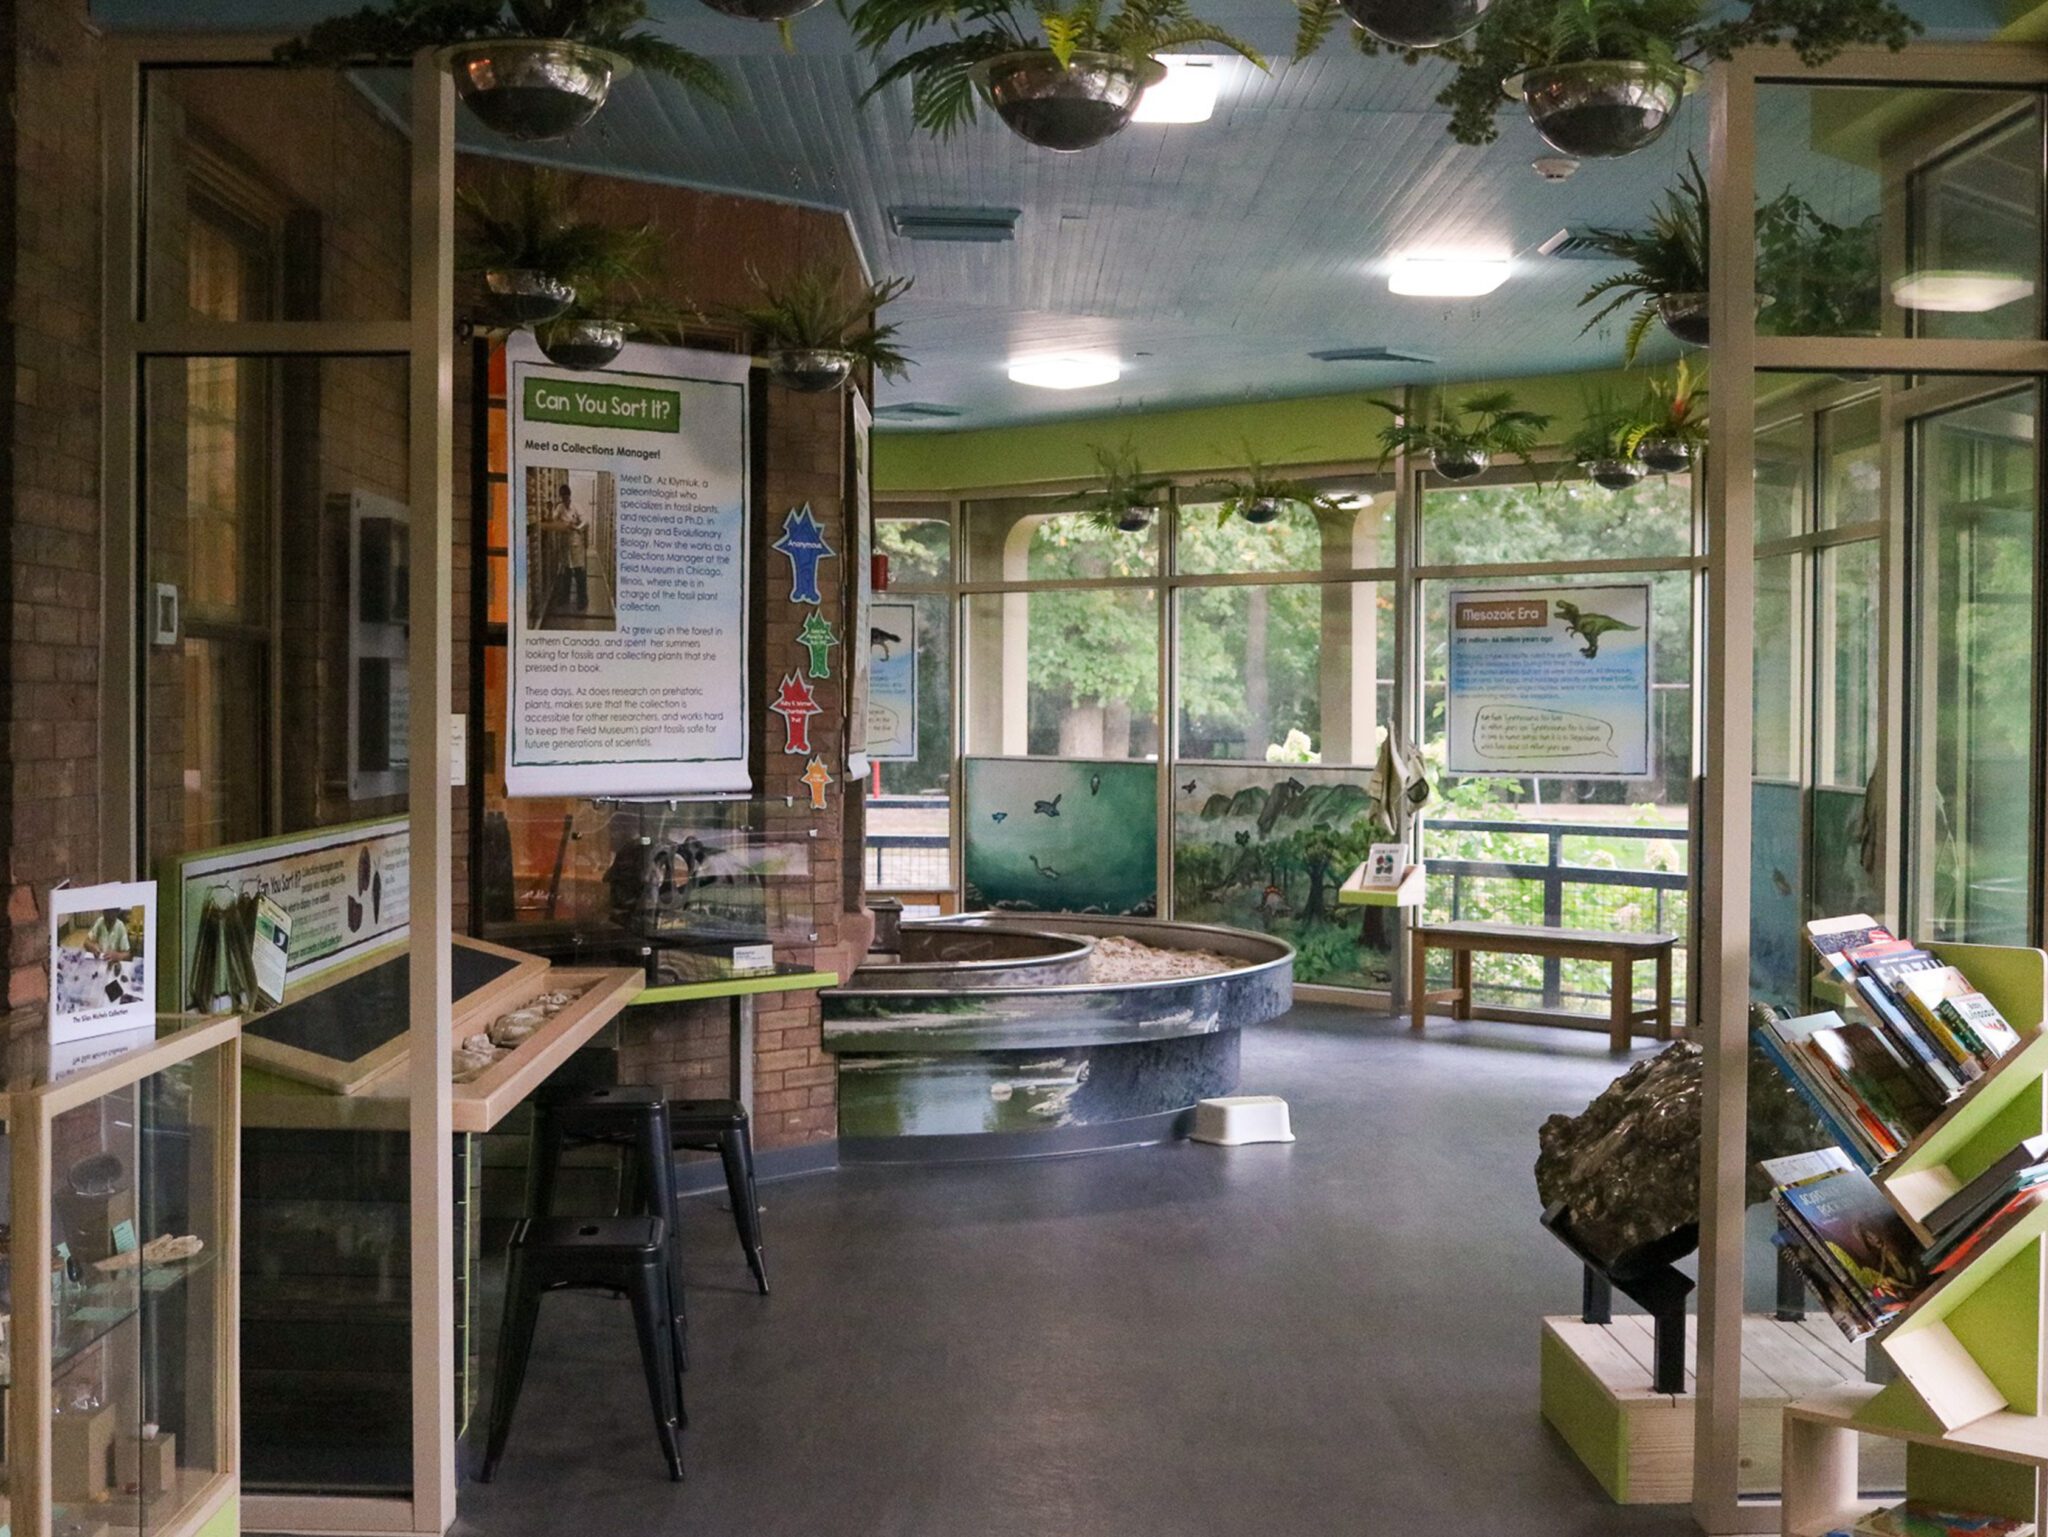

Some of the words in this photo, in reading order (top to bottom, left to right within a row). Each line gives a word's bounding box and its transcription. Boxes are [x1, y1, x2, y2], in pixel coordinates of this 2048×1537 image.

[535, 389, 570, 411] Can
[575, 393, 607, 414] You
[611, 396, 648, 418] Sort
[651, 399, 670, 420] It?
[525, 440, 550, 451] Meet
[552, 443, 559, 452] a
[561, 442, 614, 456] Collections
[616, 447, 661, 460] Manager!
[620, 473, 641, 483] Meet
[657, 477, 666, 485] Az
[620, 487, 678, 500] paleontologist
[620, 501, 663, 510] specializes
[674, 503, 691, 511] fossil
[620, 513, 637, 521] and
[639, 515, 675, 524] received
[620, 525, 652, 536] Ecology
[655, 528, 671, 536] and
[673, 528, 721, 539] Evolutionary
[653, 540, 672, 548] Now
[690, 543, 712, 551] works
[788, 539, 822, 549] Anonymous
[620, 550, 664, 560] Collections
[667, 554, 704, 565] Manager
[620, 563, 639, 573] Field
[641, 565, 675, 574] Museum
[677, 566, 684, 574] in
[647, 578, 672, 587] where
[674, 579, 688, 587] she
[620, 590, 649, 600] charge
[652, 591, 660, 599] of
[663, 591, 675, 599] the
[678, 591, 695, 600] fossil
[697, 592, 718, 601] plant
[1463, 608, 1516, 621] Mesozoic
[1518, 607, 1539, 619] Era
[632, 627, 652, 636] grew
[655, 628, 665, 636] up
[676, 627, 689, 635] the
[692, 627, 713, 635] forest
[526, 637, 560, 646] northern
[624, 639, 646, 648] spent
[650, 639, 663, 647] her
[666, 640, 701, 648] summers
[526, 650, 555, 661] looking
[558, 651, 569, 659] for
[571, 650, 594, 659] fossils
[596, 651, 614, 660] and
[616, 652, 656, 661] collecting
[658, 652, 682, 661] plants
[685, 652, 701, 660] that
[703, 652, 716, 660] she
[525, 664, 558, 673] pressed
[525, 686, 549, 695] These
[662, 688, 703, 697] prehistoric
[555, 701, 583, 709] makes
[605, 700, 622, 708] that
[640, 700, 680, 709] collection
[525, 714, 570, 722] accessible
[572, 713, 584, 721] for
[586, 713, 608, 721] other
[662, 713, 678, 721] and
[704, 712, 723, 720] hard
[536, 727, 557, 736] keep
[560, 727, 575, 735] the
[577, 726, 596, 734] Field
[599, 725, 639, 734] Museum's
[641, 725, 662, 735] plant
[664, 725, 685, 733] fossils
[687, 725, 704, 733] safe
[706, 724, 716, 732] for
[525, 740, 550, 750] future
[552, 739, 603, 751] generations
[604, 739, 613, 747] of
[270, 876, 281, 893] You
